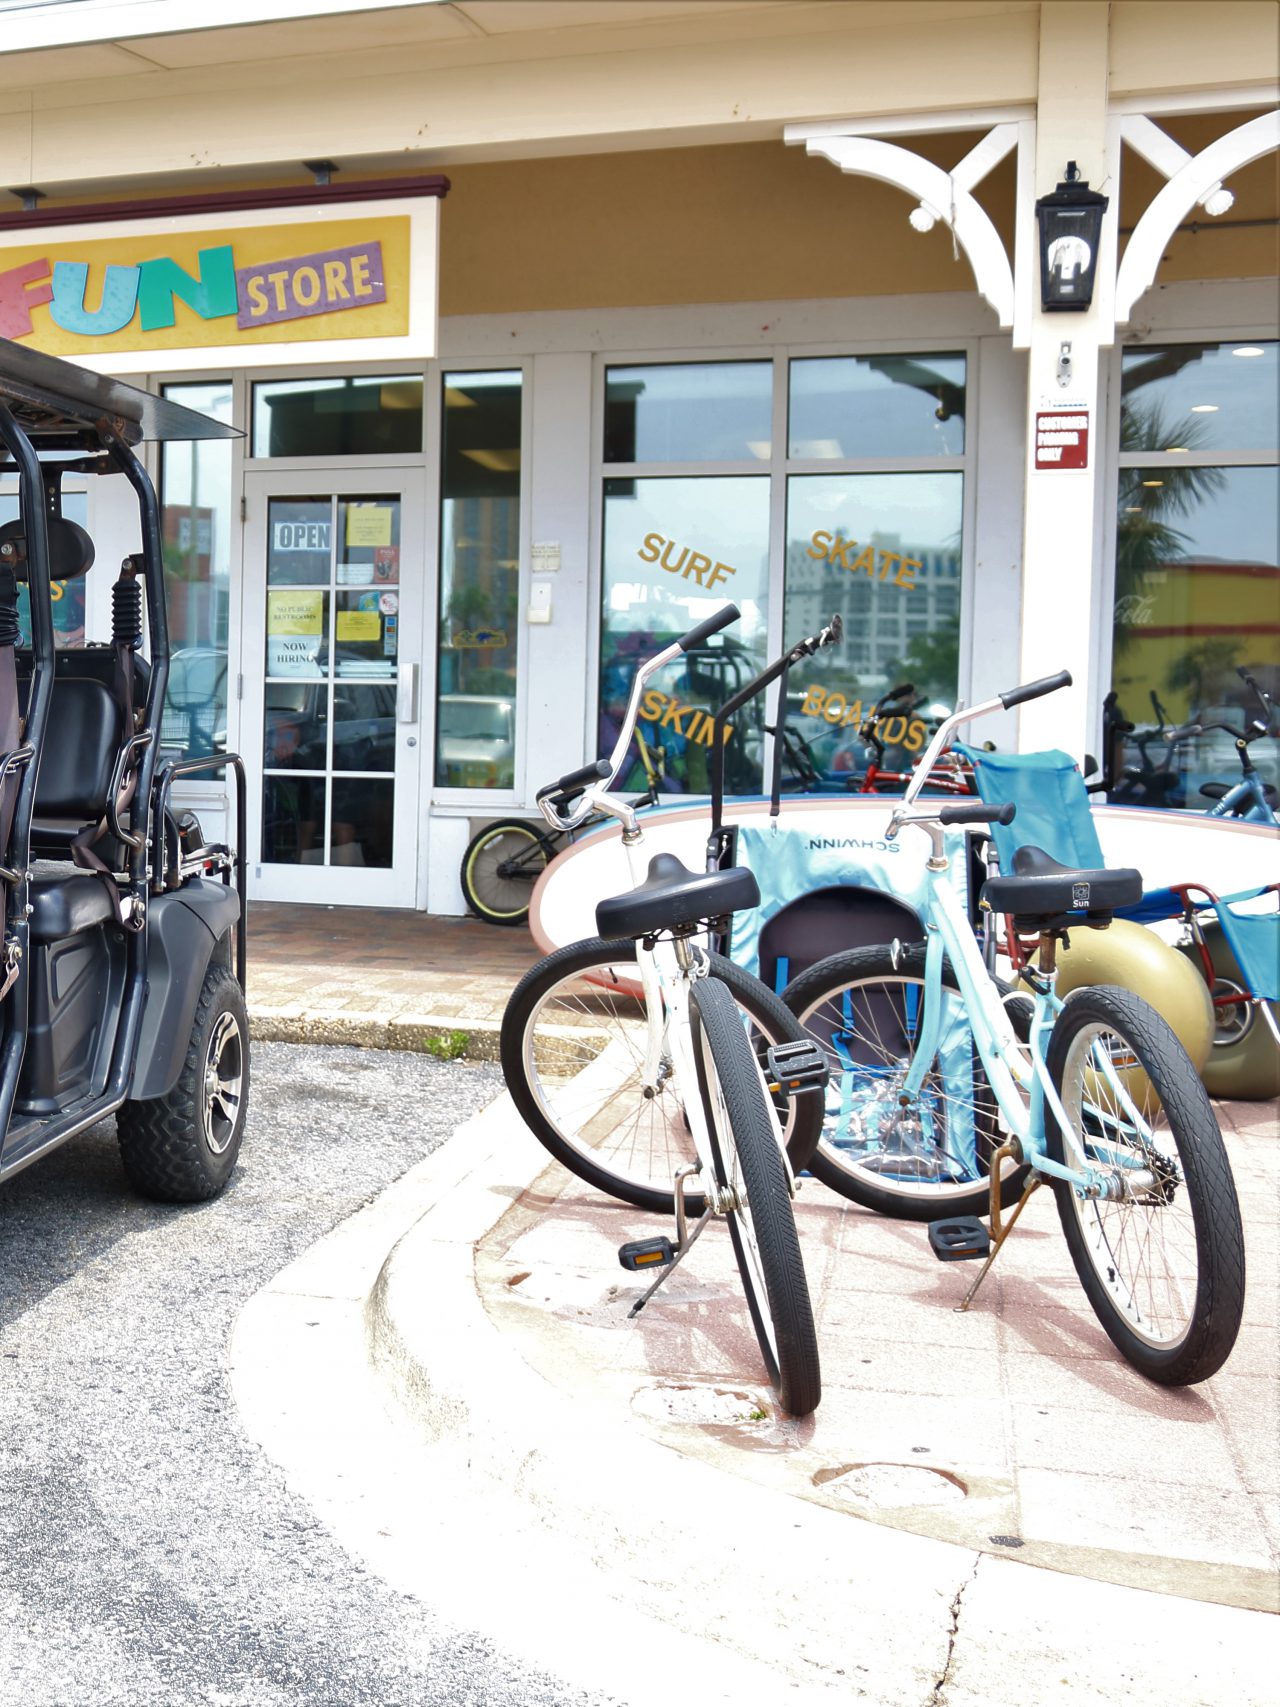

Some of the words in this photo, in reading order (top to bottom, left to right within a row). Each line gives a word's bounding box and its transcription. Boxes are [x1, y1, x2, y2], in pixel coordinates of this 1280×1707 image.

[246, 253, 373, 318] STORE
[279, 524, 330, 549] OPEN
[637, 531, 737, 591] SURF
[805, 529, 924, 591] SKATE
[282, 642, 308, 651] NOW
[276, 653, 314, 663] HIRING
[808, 838, 901, 854] SCHWINN
[1072, 899, 1090, 908] Sun
